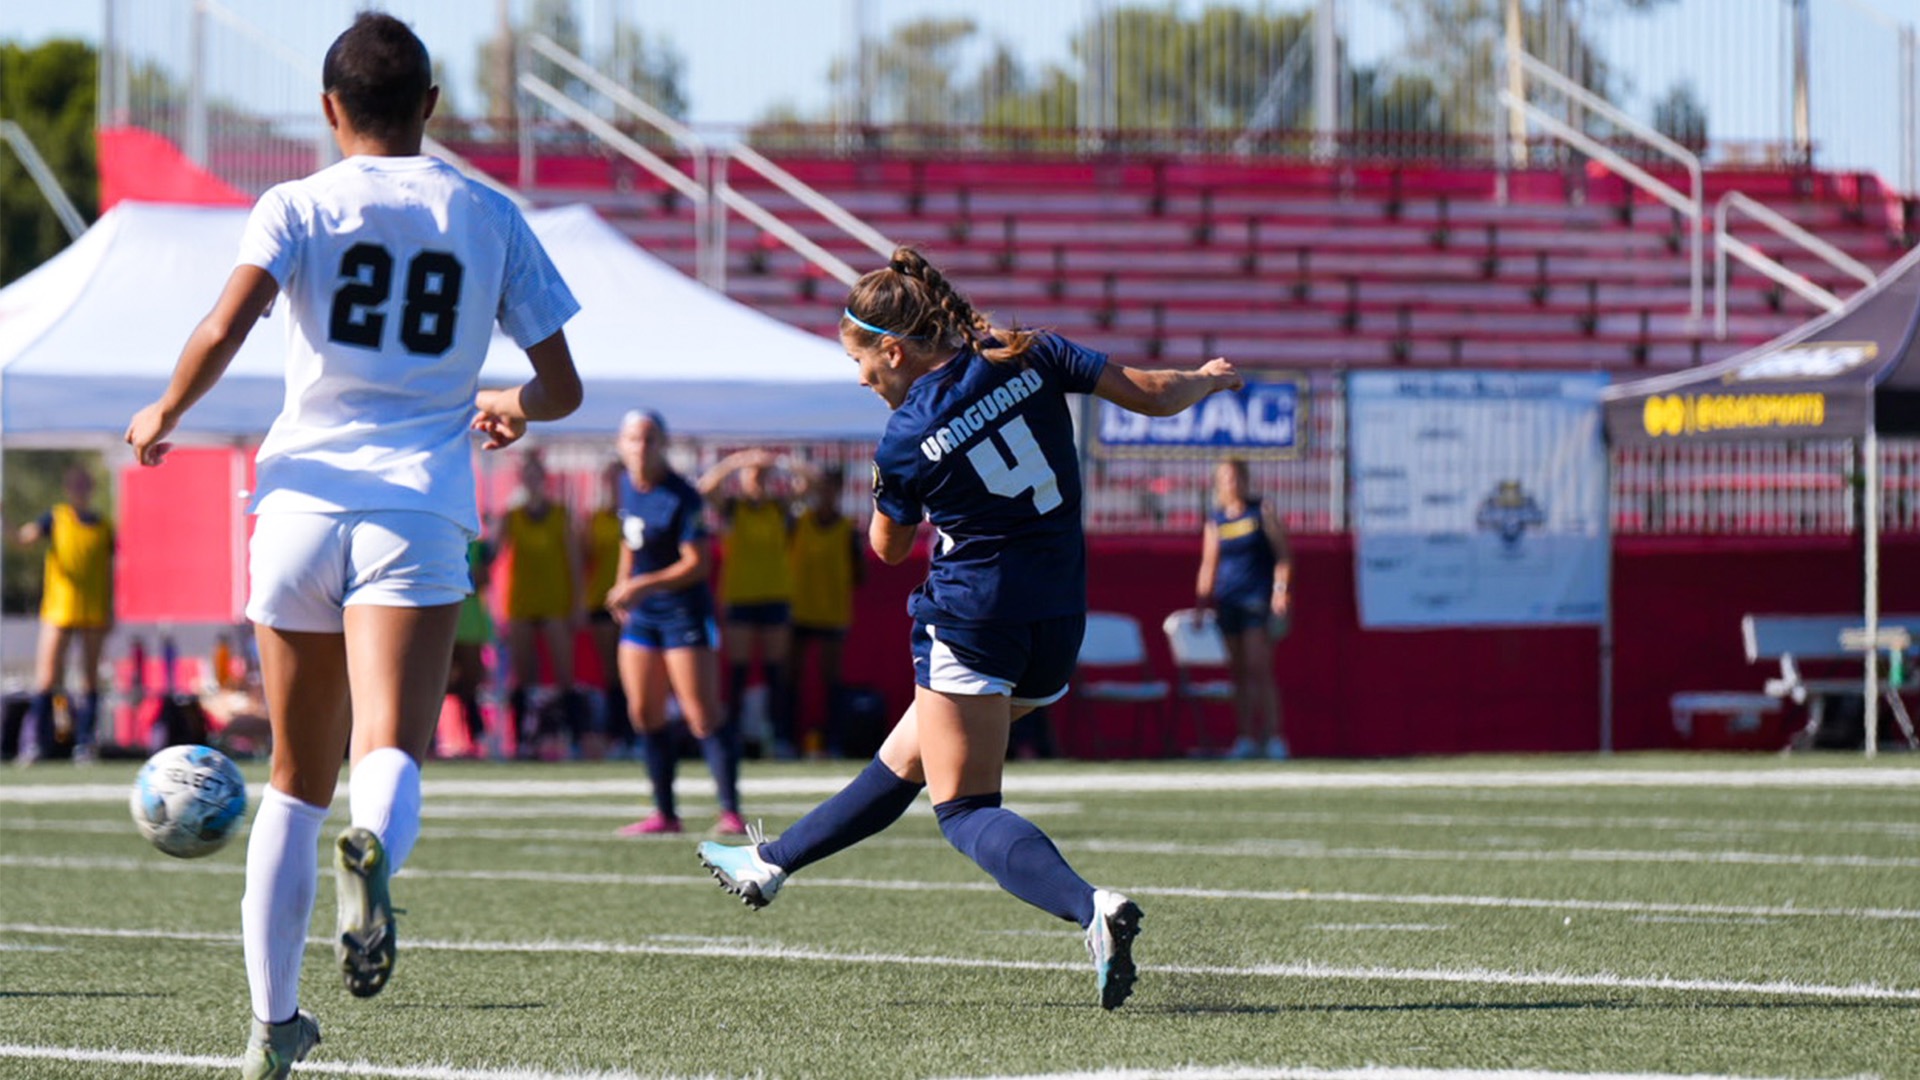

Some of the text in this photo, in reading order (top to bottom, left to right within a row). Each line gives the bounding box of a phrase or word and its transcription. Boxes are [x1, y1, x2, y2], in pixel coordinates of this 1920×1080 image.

[328, 241, 465, 358] 28
[920, 367, 1043, 462] VANGUARD
[965, 414, 1063, 516] 4
